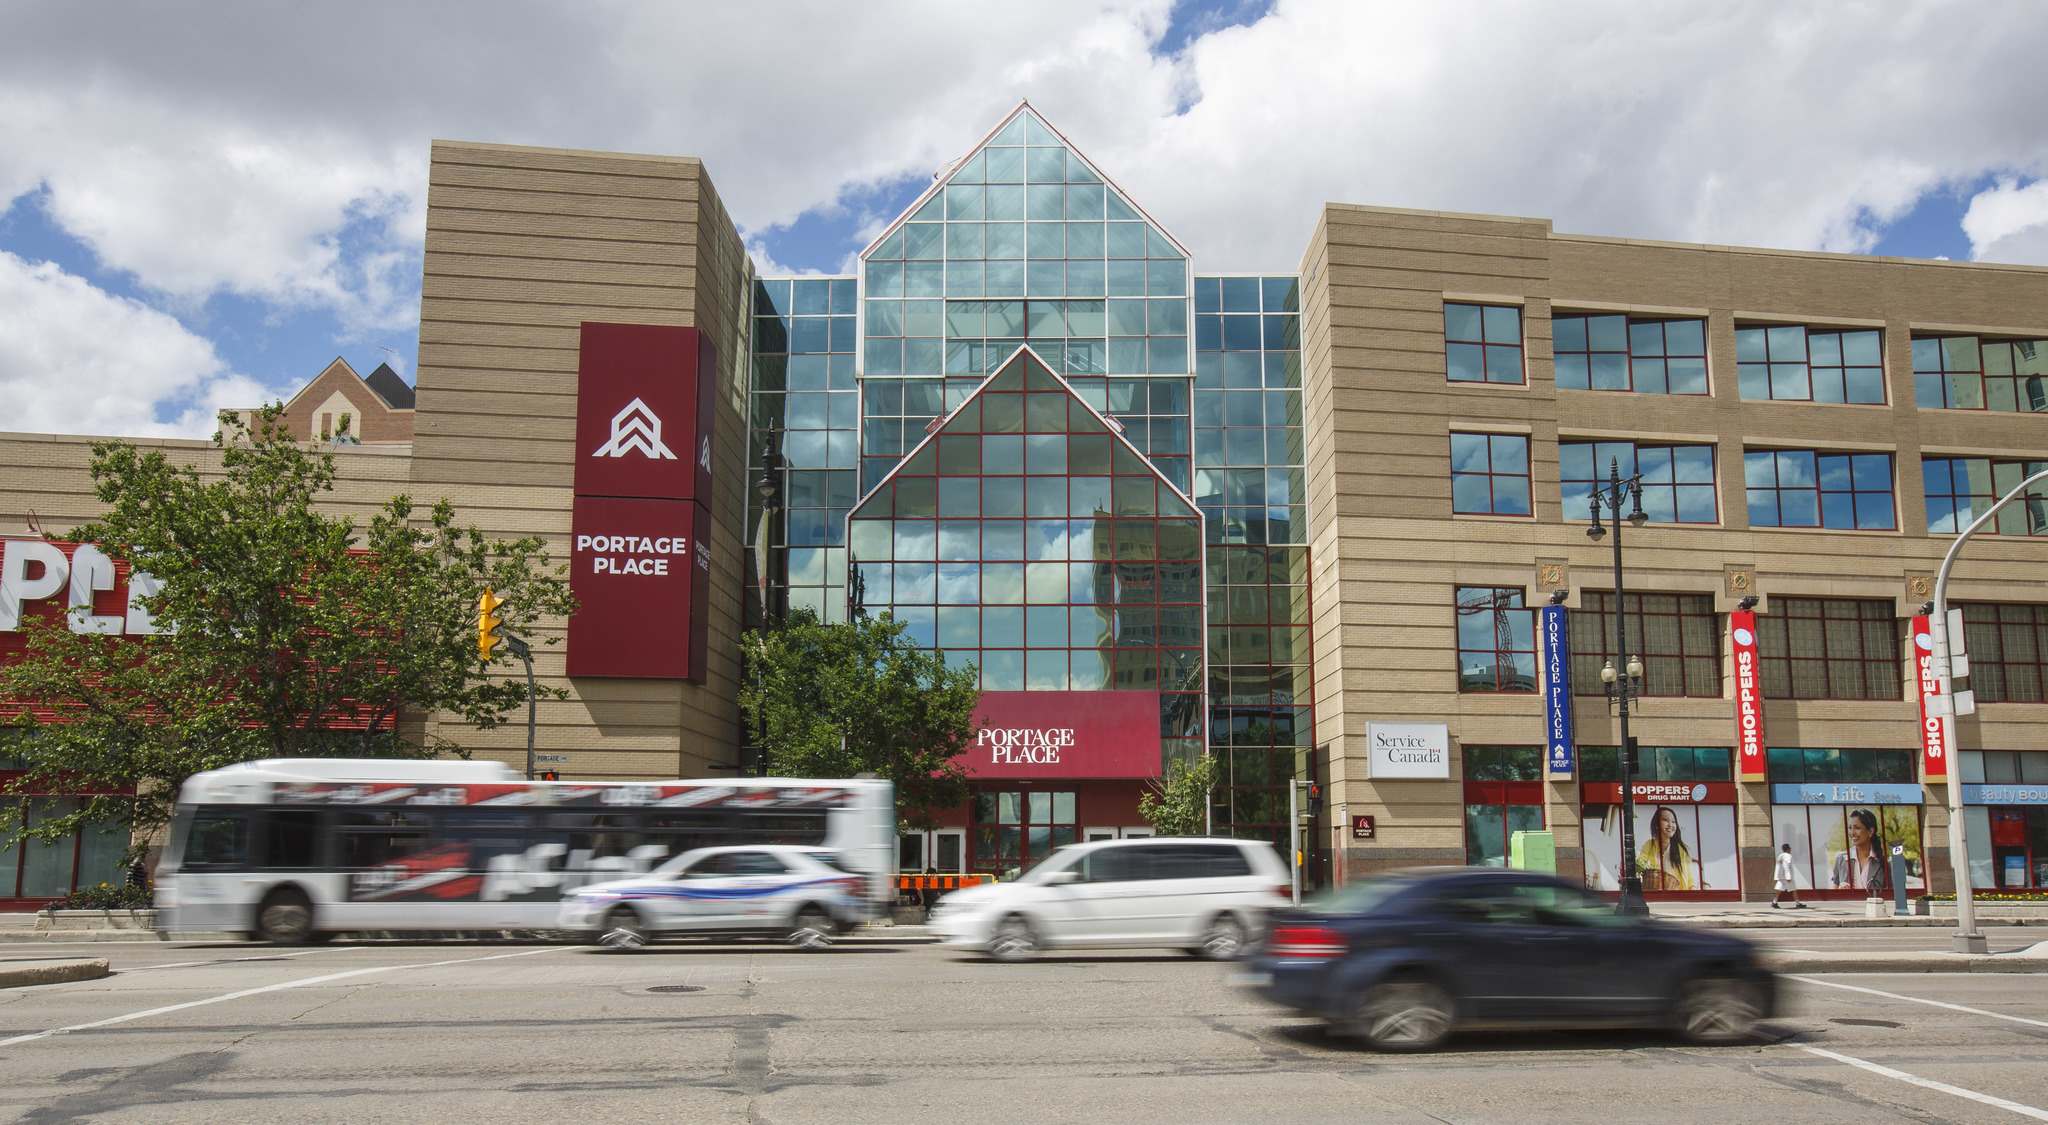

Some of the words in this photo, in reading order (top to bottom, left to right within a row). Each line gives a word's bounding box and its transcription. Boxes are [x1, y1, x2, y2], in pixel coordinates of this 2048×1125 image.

[577, 535, 686, 554] PORTAGE
[594, 557, 668, 575] PLACE
[1549, 612, 1561, 684] PORTAGE
[1739, 651, 1757, 756] SHOPPERS
[1553, 687, 1563, 739] PLACE
[977, 728, 1075, 746] PORTAGE
[1376, 732, 1425, 748] Service
[991, 745, 1060, 764] PLACE
[1388, 748, 1440, 763] Canada
[1832, 785, 1864, 801] Life
